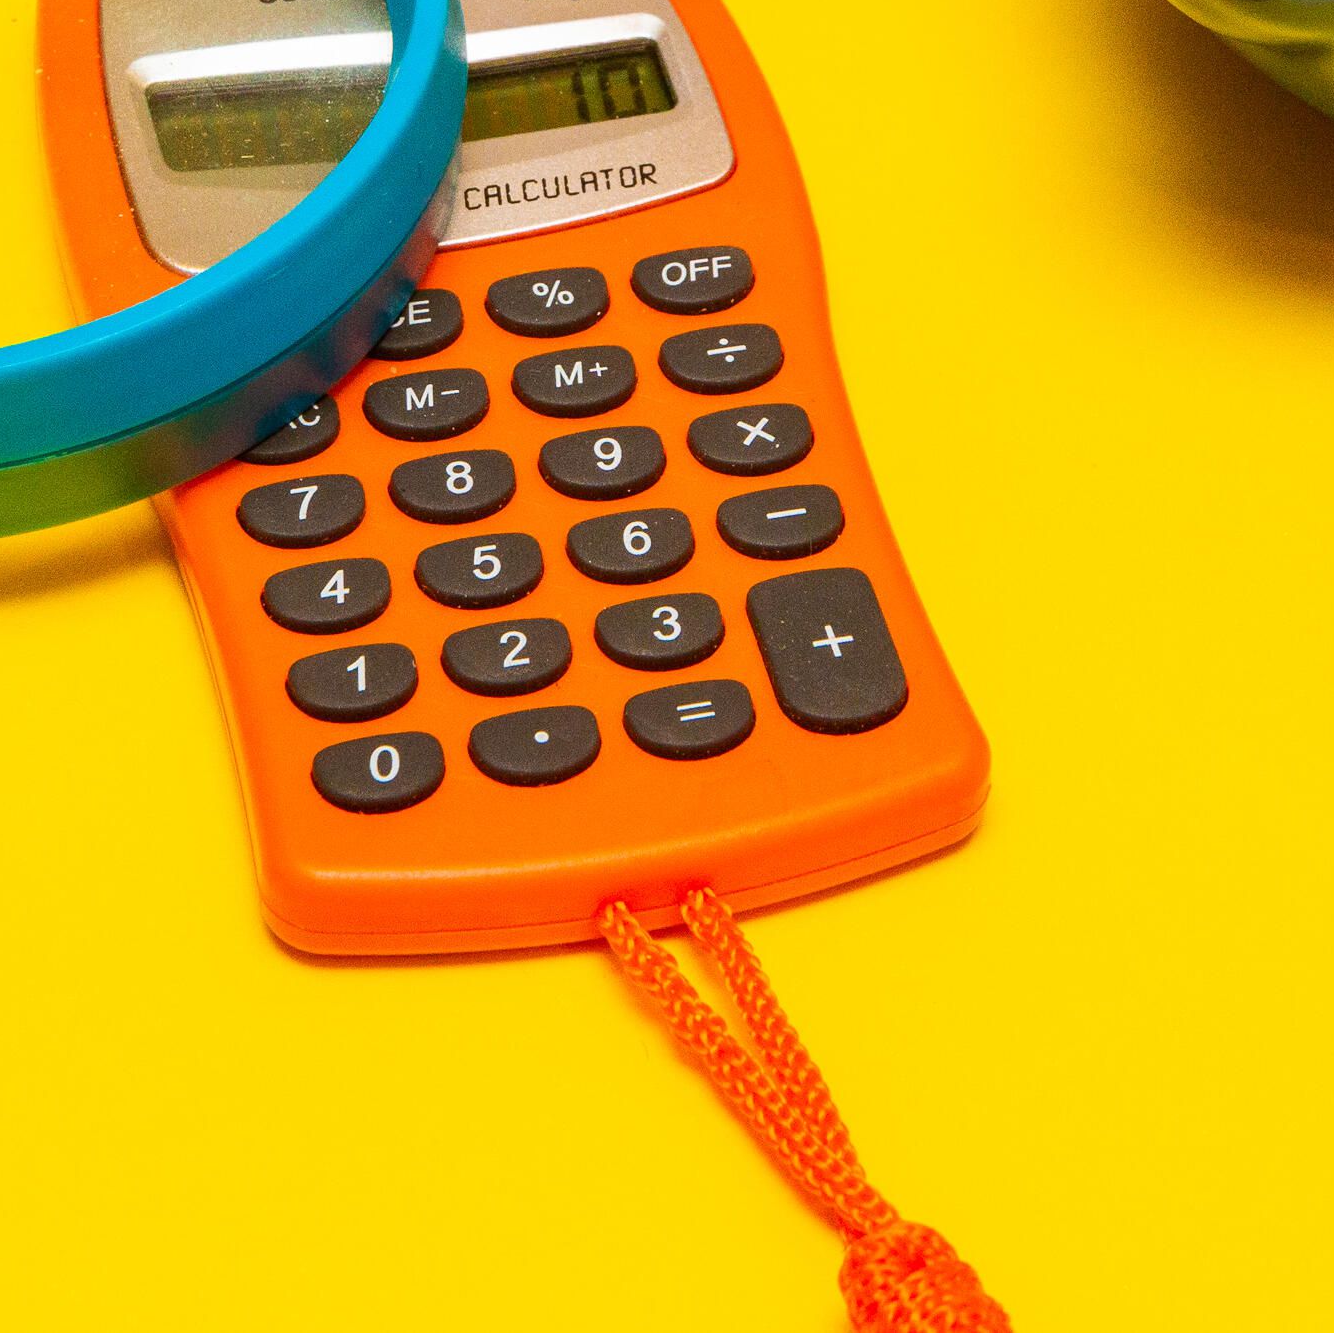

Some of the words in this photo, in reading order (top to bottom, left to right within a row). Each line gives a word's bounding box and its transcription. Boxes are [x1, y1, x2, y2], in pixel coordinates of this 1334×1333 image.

[463, 163, 658, 211] CALCULATOR
[661, 255, 733, 286] OFF
[532, 279, 575, 308] %
[390, 300, 432, 328] E
[554, 361, 609, 388] M+
[593, 437, 623, 471] 9
[445, 460, 474, 495] 8
[289, 485, 319, 521] 7
[622, 521, 652, 556] 6
[472, 544, 502, 580] 5
[320, 569, 351, 604] 4
[652, 606, 682, 641] 3
[812, 624, 854, 658] +
[499, 631, 531, 668] 2
[346, 655, 368, 692] 1
[369, 745, 400, 782] 0
